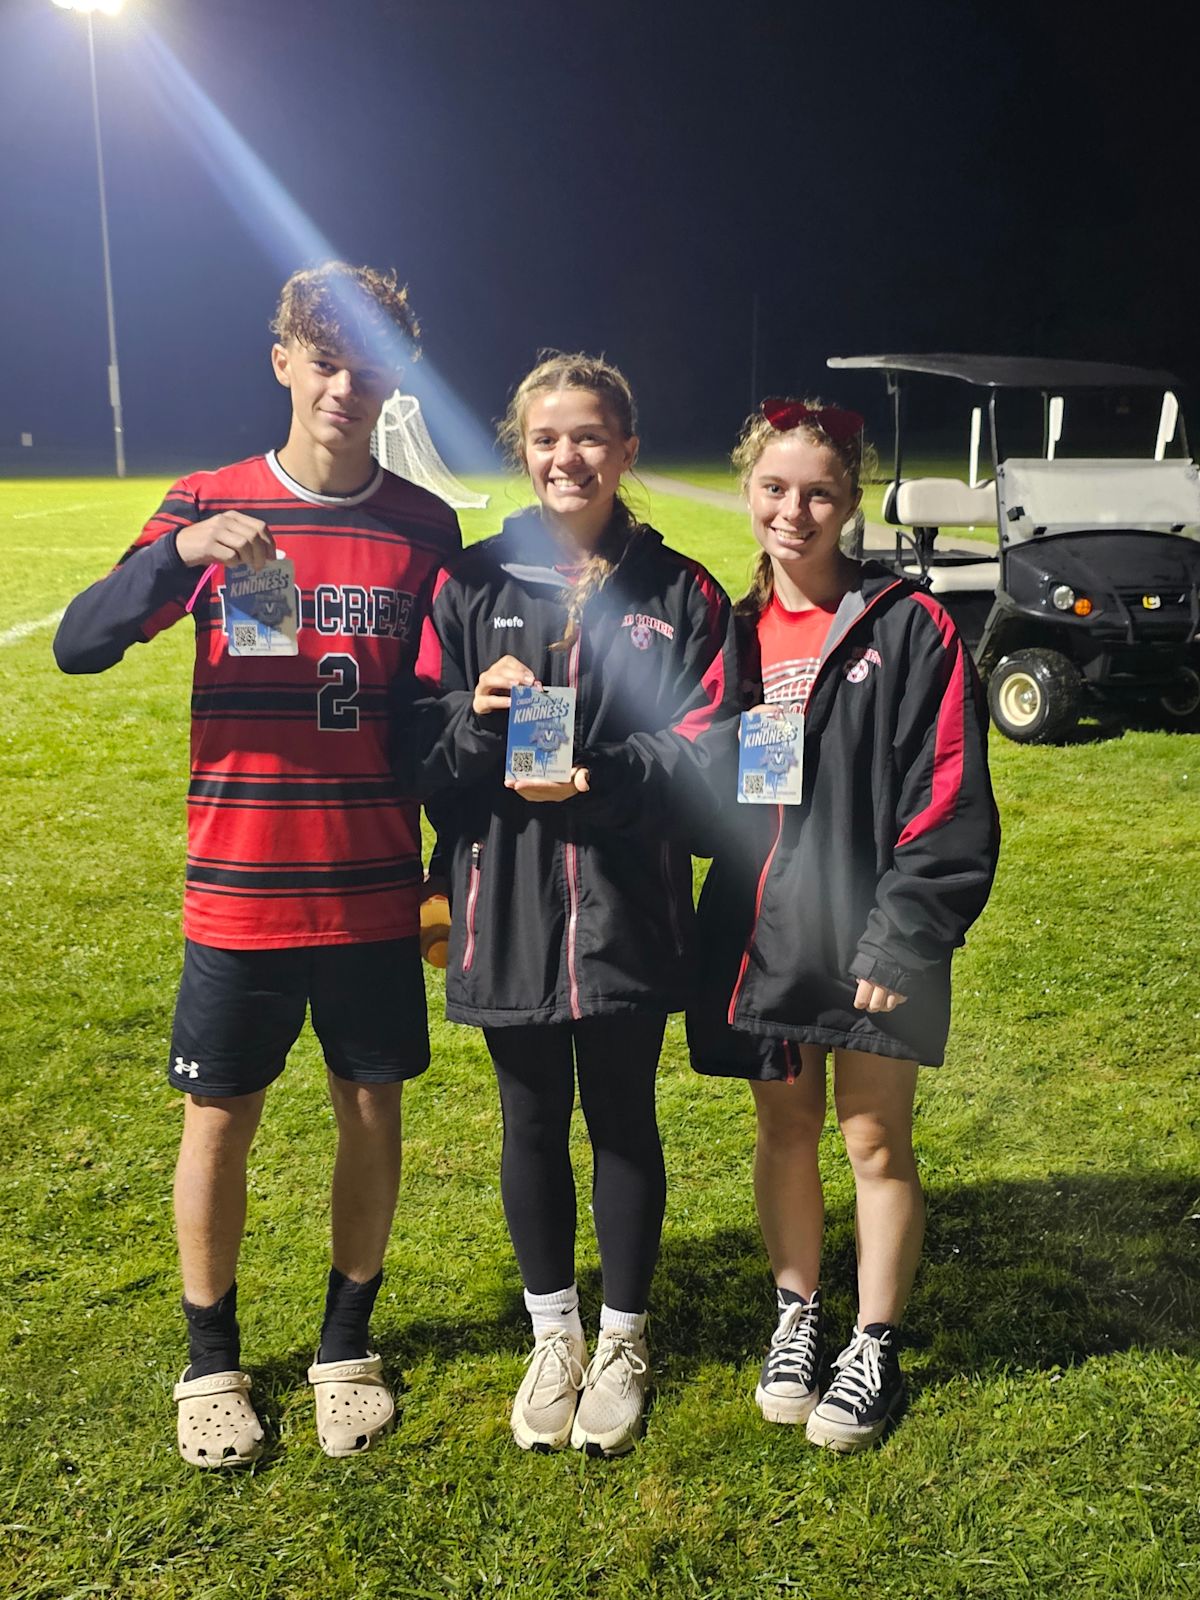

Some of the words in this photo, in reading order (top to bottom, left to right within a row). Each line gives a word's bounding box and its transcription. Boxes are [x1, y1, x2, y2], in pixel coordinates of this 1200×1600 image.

[494, 615, 524, 629] Keefe
[317, 653, 360, 731] 2
[513, 703, 569, 724] KINDNESS
